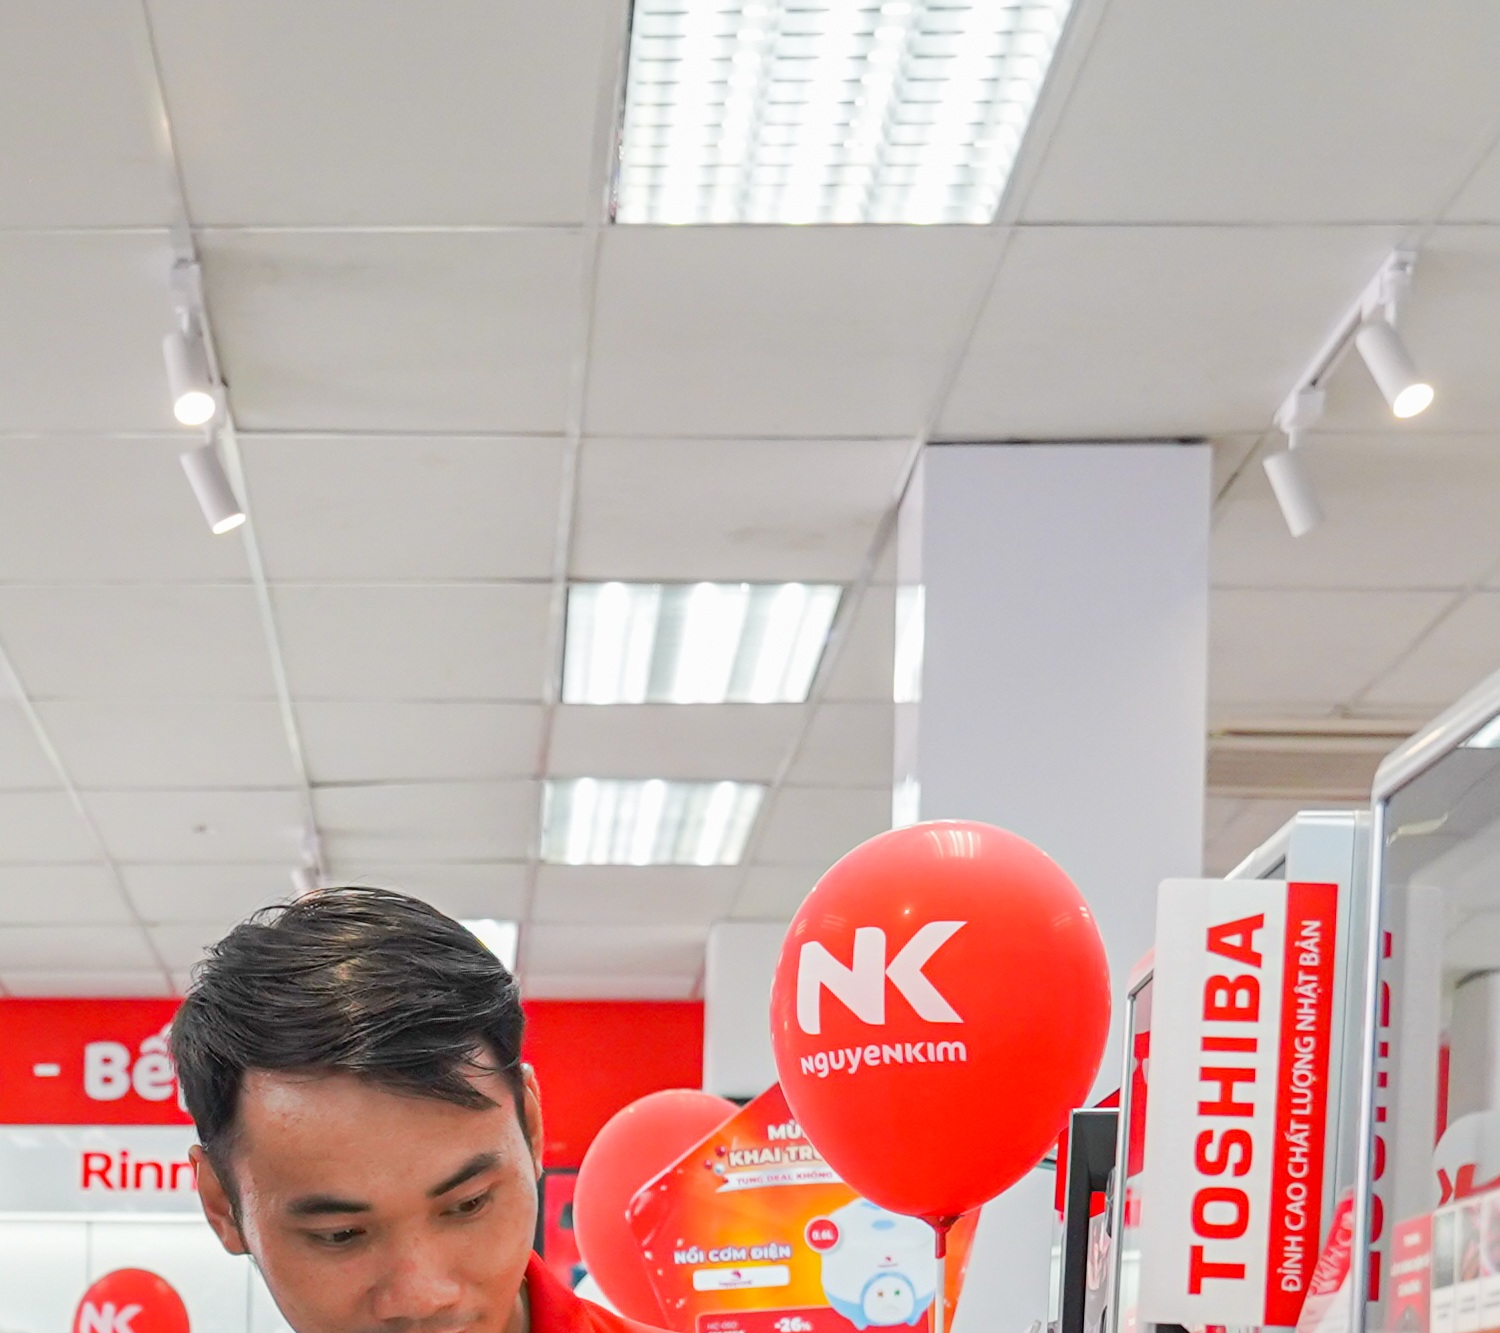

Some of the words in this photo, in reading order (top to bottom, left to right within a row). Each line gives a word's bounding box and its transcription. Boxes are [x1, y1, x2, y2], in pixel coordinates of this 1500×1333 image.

[1298, 919, 1321, 967] BẢN
[796, 920, 968, 1035] NK
[1296, 970, 1320, 1032] NHẬT
[1293, 1036, 1316, 1115] LƯỢNG
[1188, 913, 1265, 1296] TOSHIBA
[727, 1147, 781, 1167] KHAI
[767, 1172, 794, 1182] DEAL
[1285, 1119, 1311, 1179] CHẤT
[1285, 1182, 1307, 1231] CAO
[708, 1245, 748, 1263] CƠM
[1280, 1236, 1304, 1293] ĐỈNH
